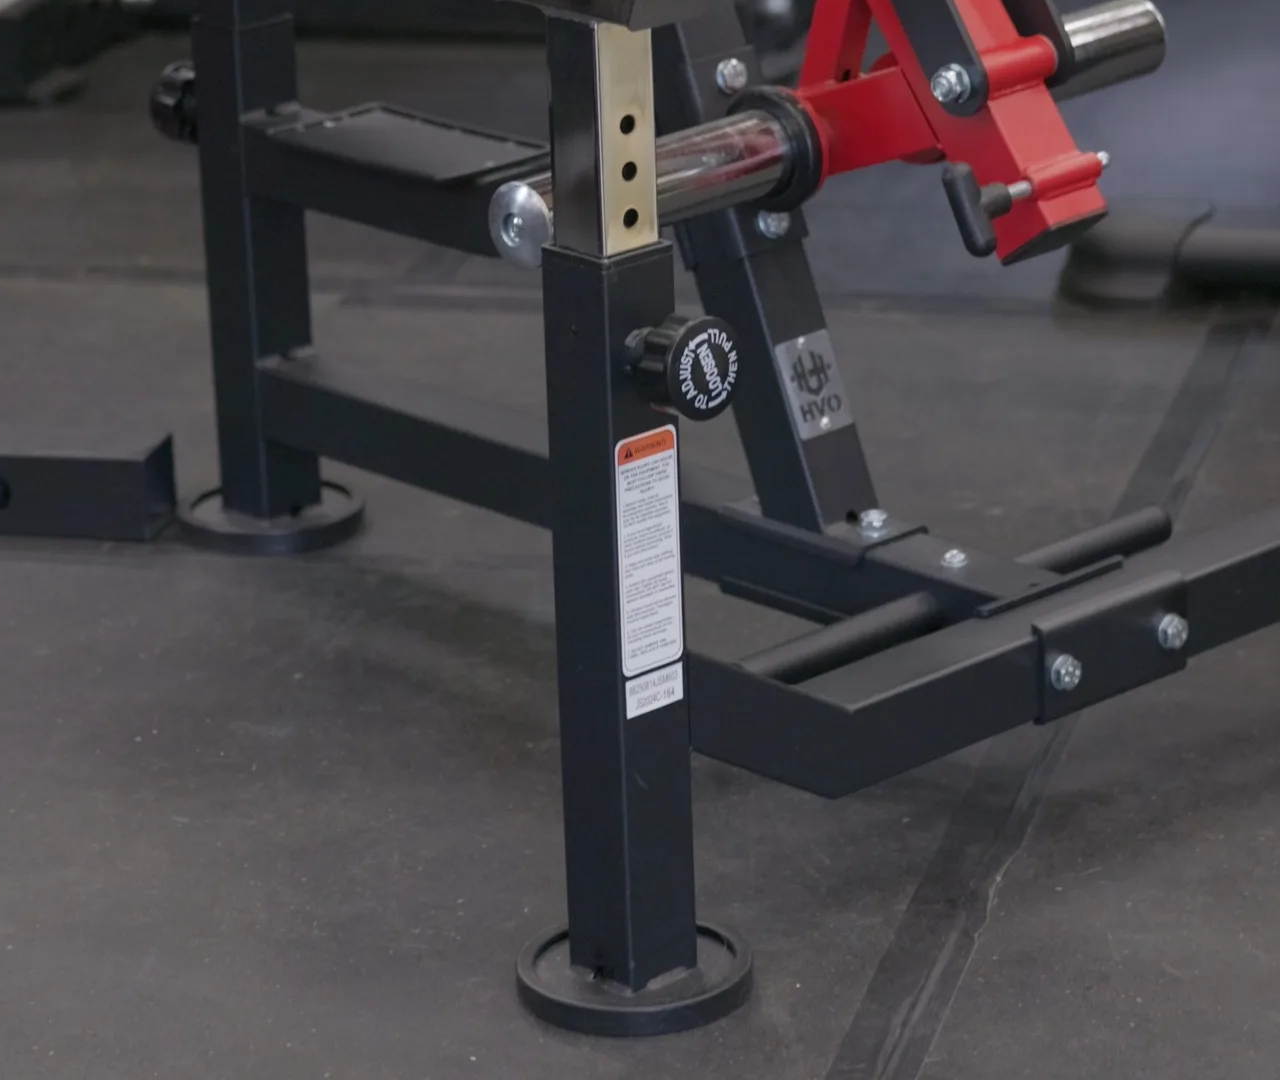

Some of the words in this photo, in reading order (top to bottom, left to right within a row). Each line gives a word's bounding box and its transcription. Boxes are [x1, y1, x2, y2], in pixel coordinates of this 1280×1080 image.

[707, 328, 733, 352] PULL
[679, 346, 698, 400] ADJUST
[697, 342, 723, 397] LOOSEN
[723, 350, 738, 392] THEN
[695, 393, 708, 410] TO
[800, 393, 842, 424] HVO
